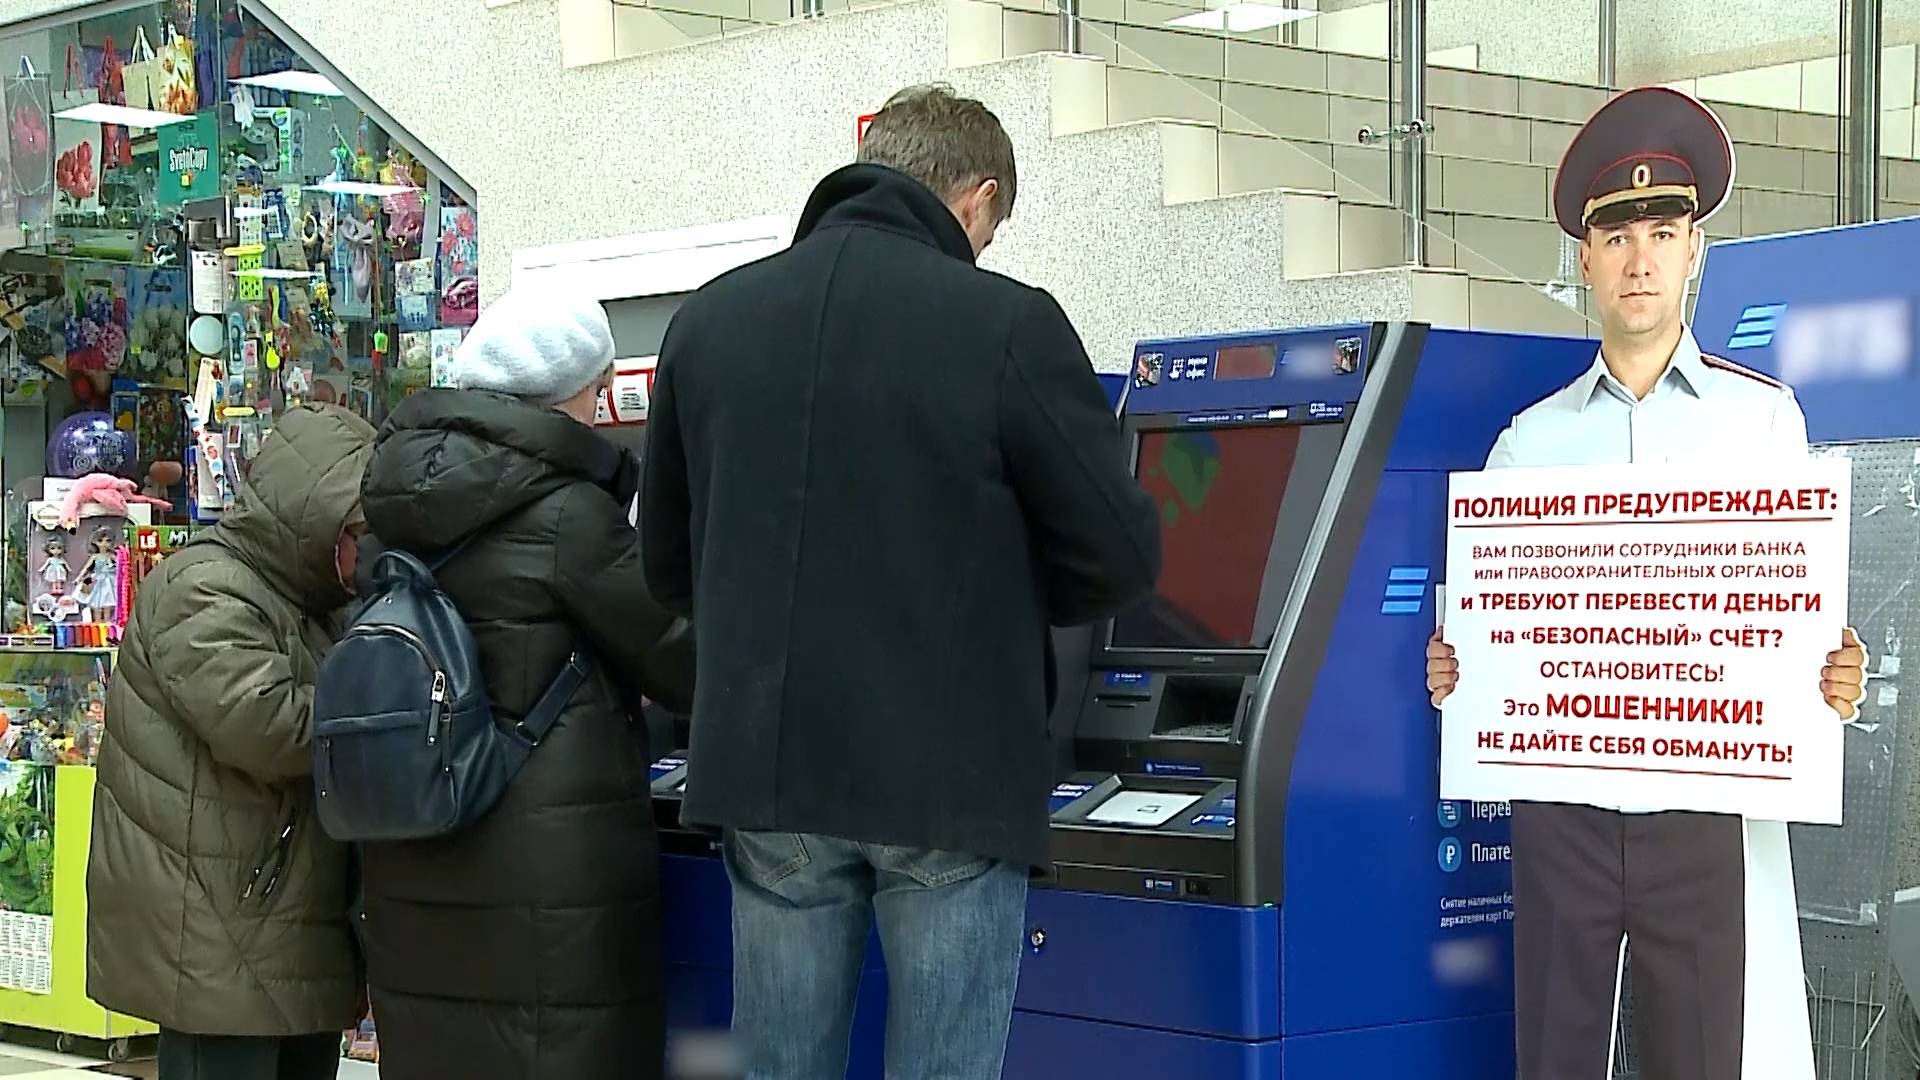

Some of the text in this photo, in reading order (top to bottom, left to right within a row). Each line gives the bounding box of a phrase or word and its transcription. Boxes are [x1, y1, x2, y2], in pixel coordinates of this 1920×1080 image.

[1454, 487, 1838, 519] ПОЛИЦИЯ ПРЕДУПРЕЖДАЕТ:
[1472, 540, 1807, 560] ВАМ ПОЗВОНИЛИ СОТРУДНИКИ БАНКА
[1474, 564, 1808, 580] или ПРАВООХРАНИТЕЛЬНЫХ ОРГАНОВ
[1460, 592, 1822, 615] и ТРЕБУЮТ ПЕРЕВЕСТИ ДЕНЬГИ
[1490, 623, 1783, 648] на «БЕЗОПАСНЫЙ» СЧЁТ?
[1539, 660, 1726, 683] ОСТАНОВИТЕСЬ!
[1502, 692, 1765, 727] Это МОШЕННИКИ!
[1477, 729, 1794, 765] НЕ ДАЙТЕ СЕБЯ ОБМАНУТЬ!
[1471, 843, 1513, 862] Плате
